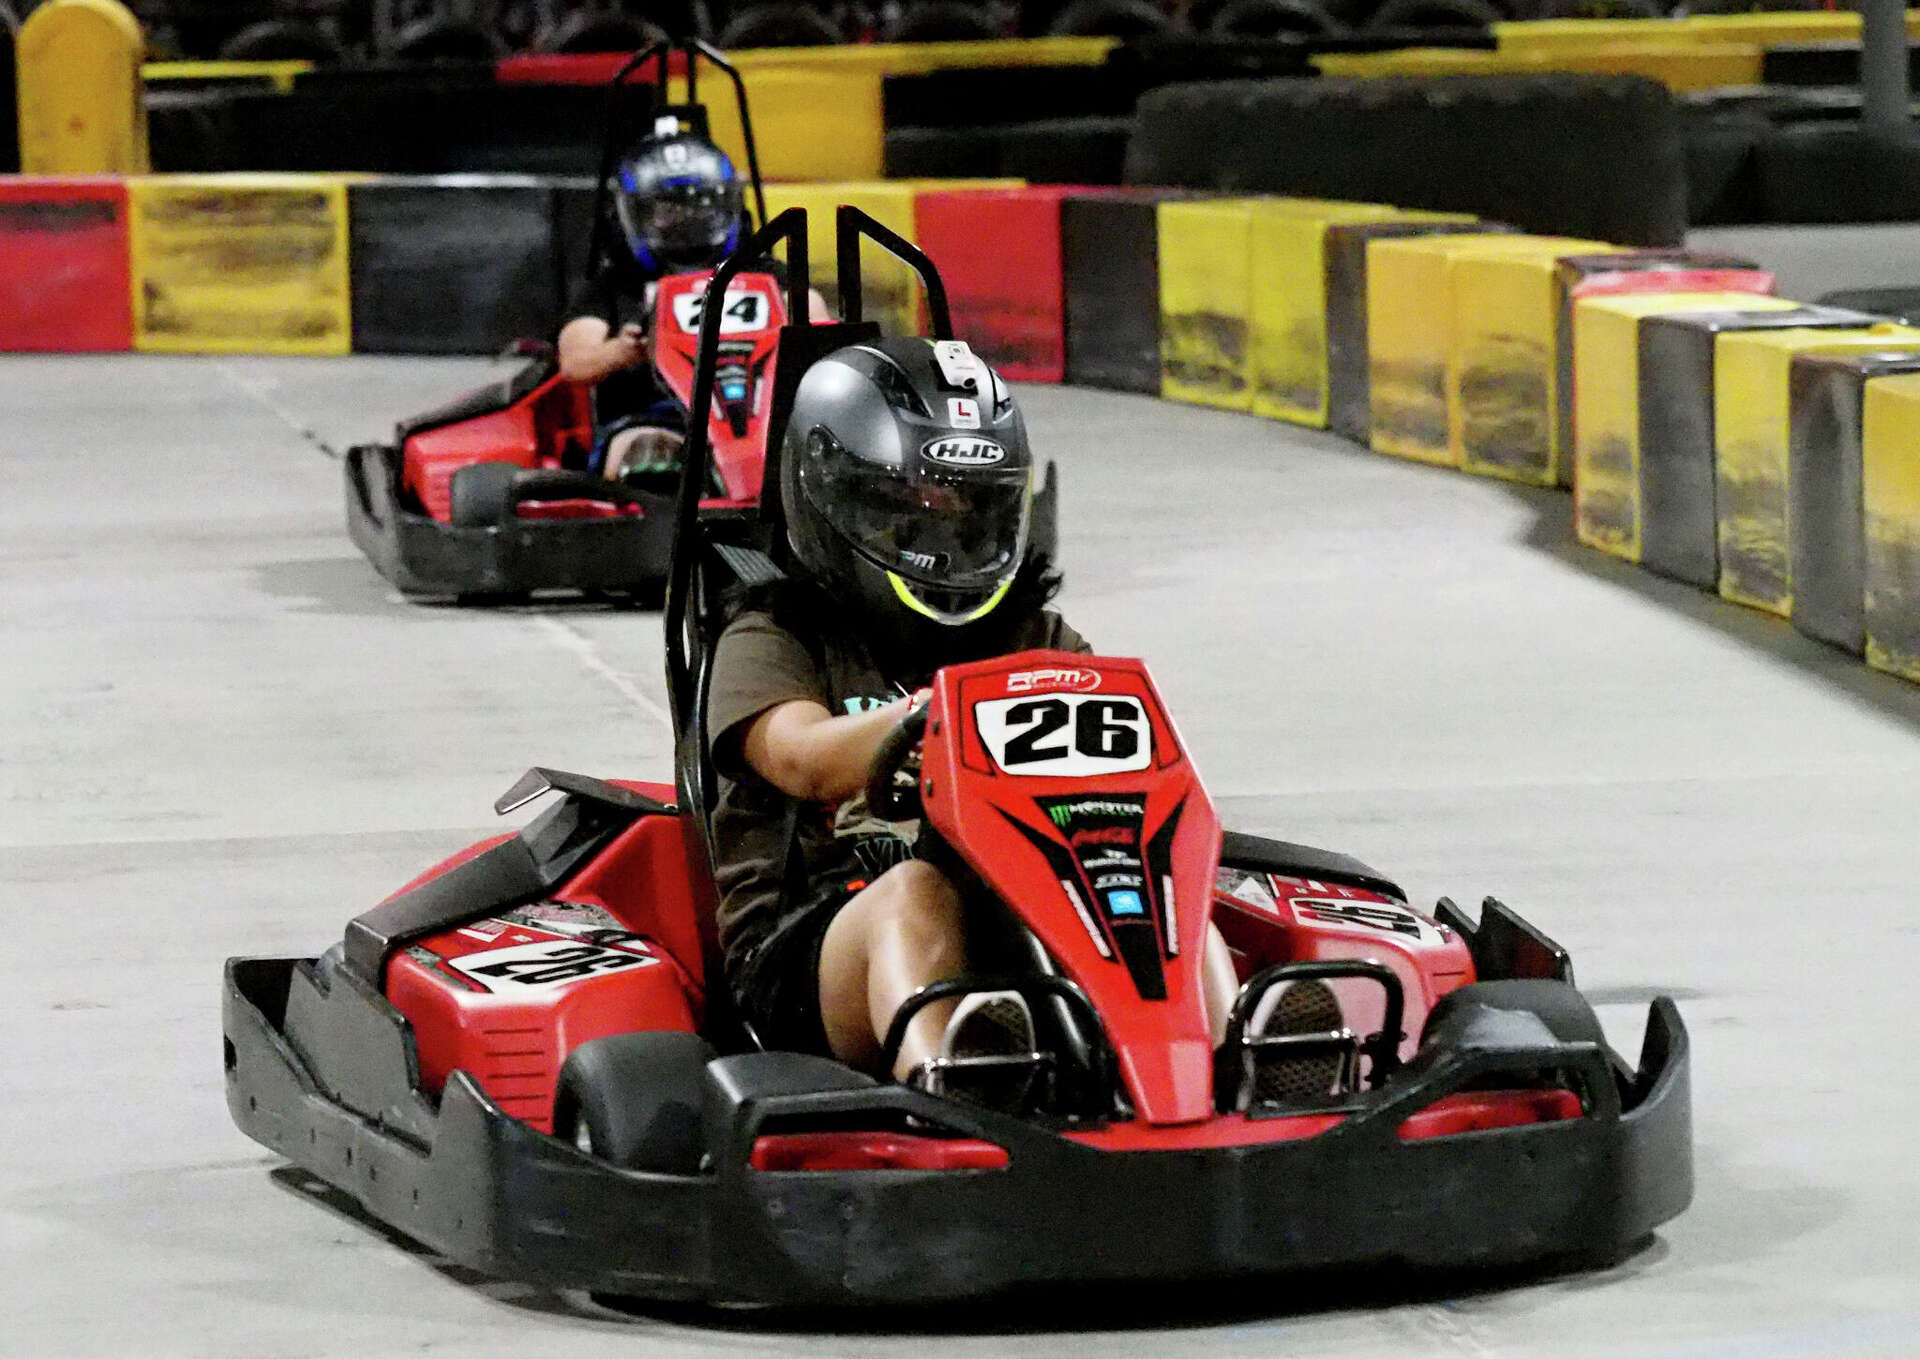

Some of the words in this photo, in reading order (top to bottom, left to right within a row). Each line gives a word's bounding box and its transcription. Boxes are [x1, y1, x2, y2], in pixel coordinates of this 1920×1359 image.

[958, 401, 972, 416] L
[936, 443, 1000, 459] HJC
[1004, 698, 1139, 766] 26
